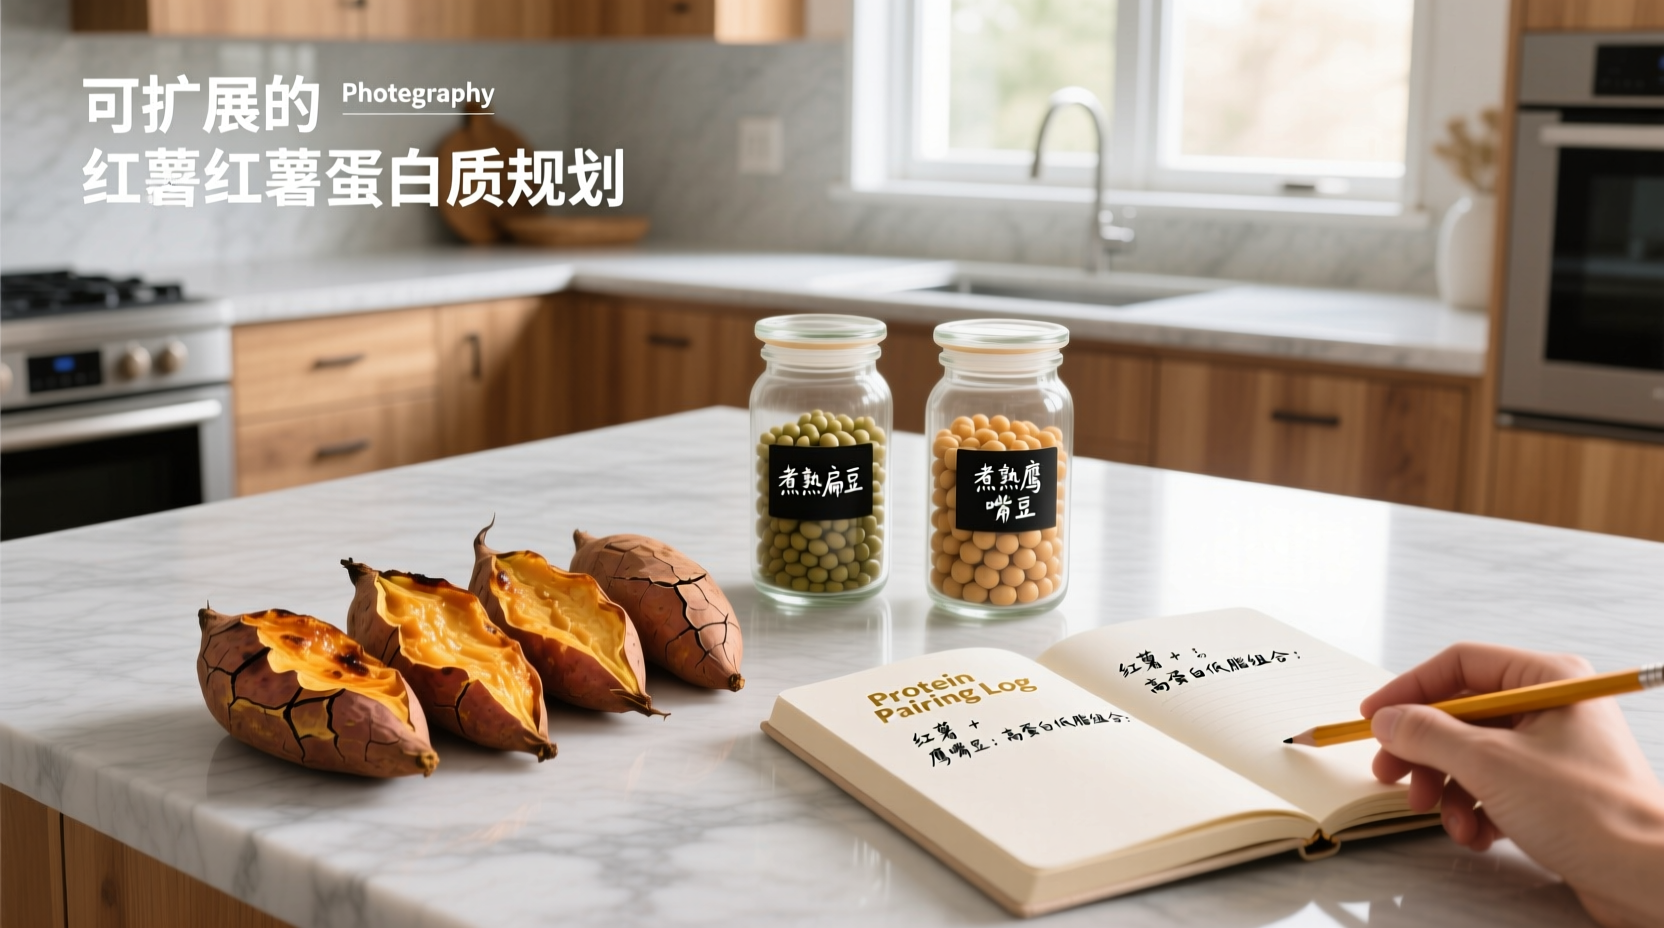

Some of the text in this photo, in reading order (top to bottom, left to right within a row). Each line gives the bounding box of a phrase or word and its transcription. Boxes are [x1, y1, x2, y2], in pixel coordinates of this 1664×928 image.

[778, 464, 863, 498] 煮熟扁豆
[974, 460, 1041, 494] 煮熟鹰
[985, 495, 1036, 524] 嘴豆
[867, 673, 976, 707] Protein
[874, 677, 1038, 724] Pairing Log
